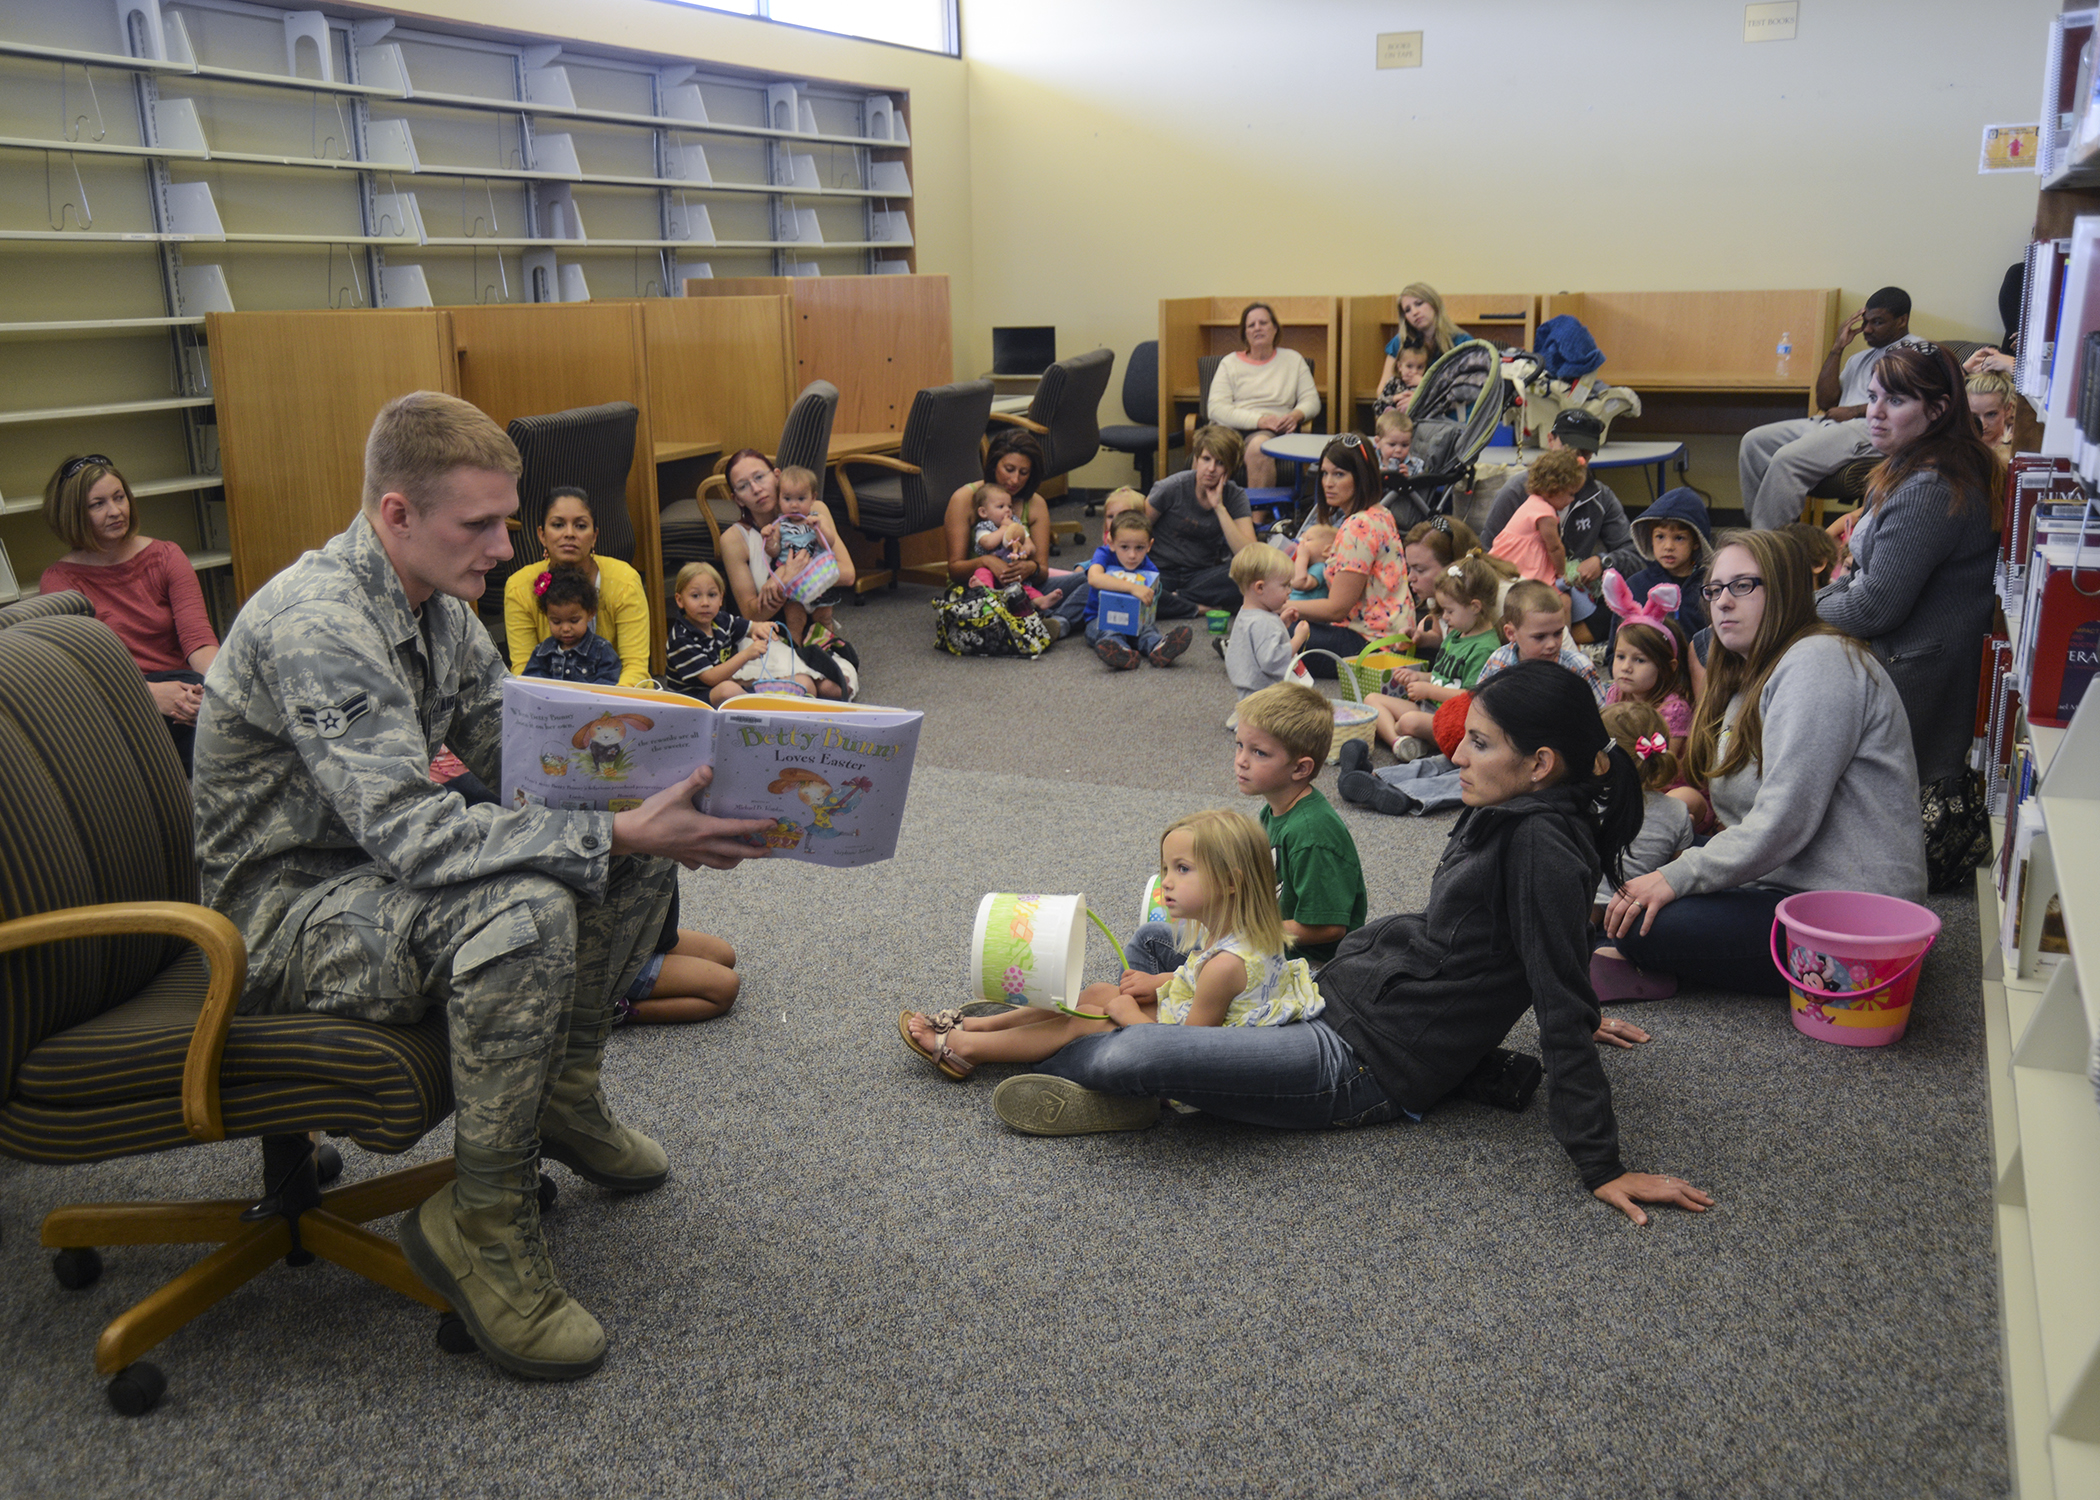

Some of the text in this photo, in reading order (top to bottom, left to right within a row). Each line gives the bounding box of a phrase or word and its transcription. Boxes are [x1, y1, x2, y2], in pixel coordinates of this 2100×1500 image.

[1767, 17, 1794, 25] BOOKS
[2037, 491, 2087, 500] HUMA
[650, 735, 677, 744] rewards
[739, 724, 819, 750] Betty
[821, 726, 906, 762] Bunny
[664, 742, 690, 750] sweeter.
[775, 750, 866, 771] Loves Easter
